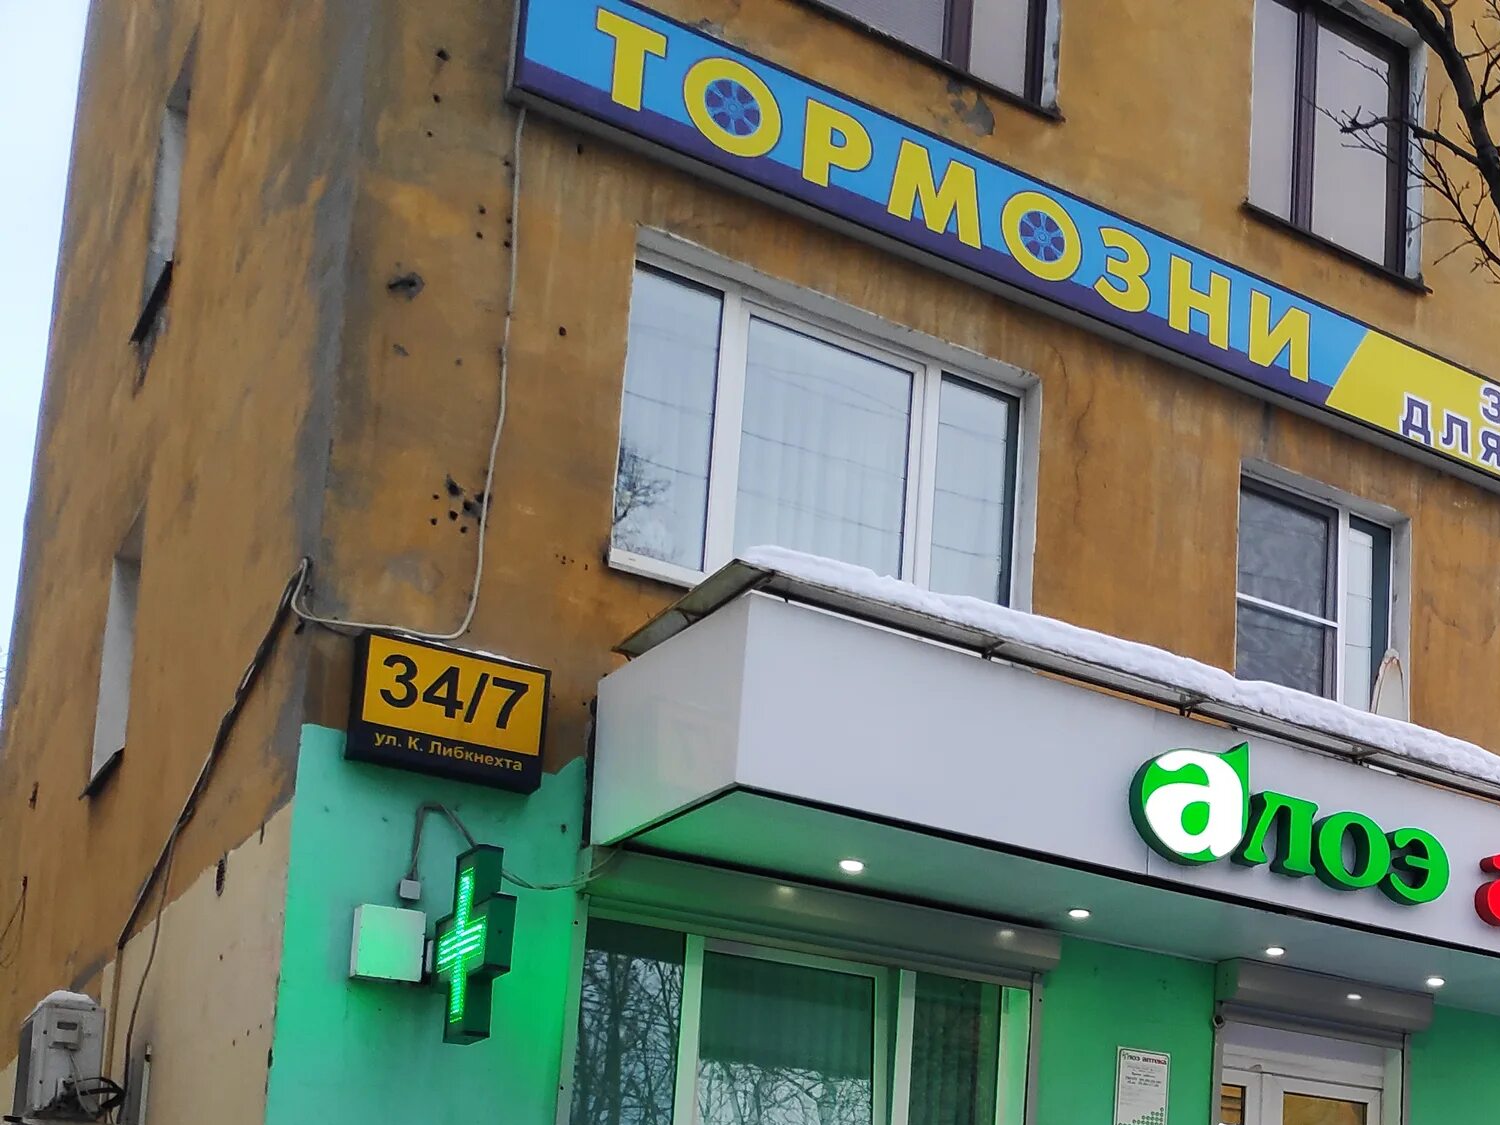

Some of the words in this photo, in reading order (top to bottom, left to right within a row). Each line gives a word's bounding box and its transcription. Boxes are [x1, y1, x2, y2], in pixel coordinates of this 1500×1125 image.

[595, 7, 1312, 383] ТОРМОЗНИ
[374, 732, 402, 747] ул.
[408, 736, 424, 752] К.
[428, 740, 523, 771] Либкнехта
[379, 653, 530, 730] 34/7
[1129, 741, 1451, 906] алоэ
